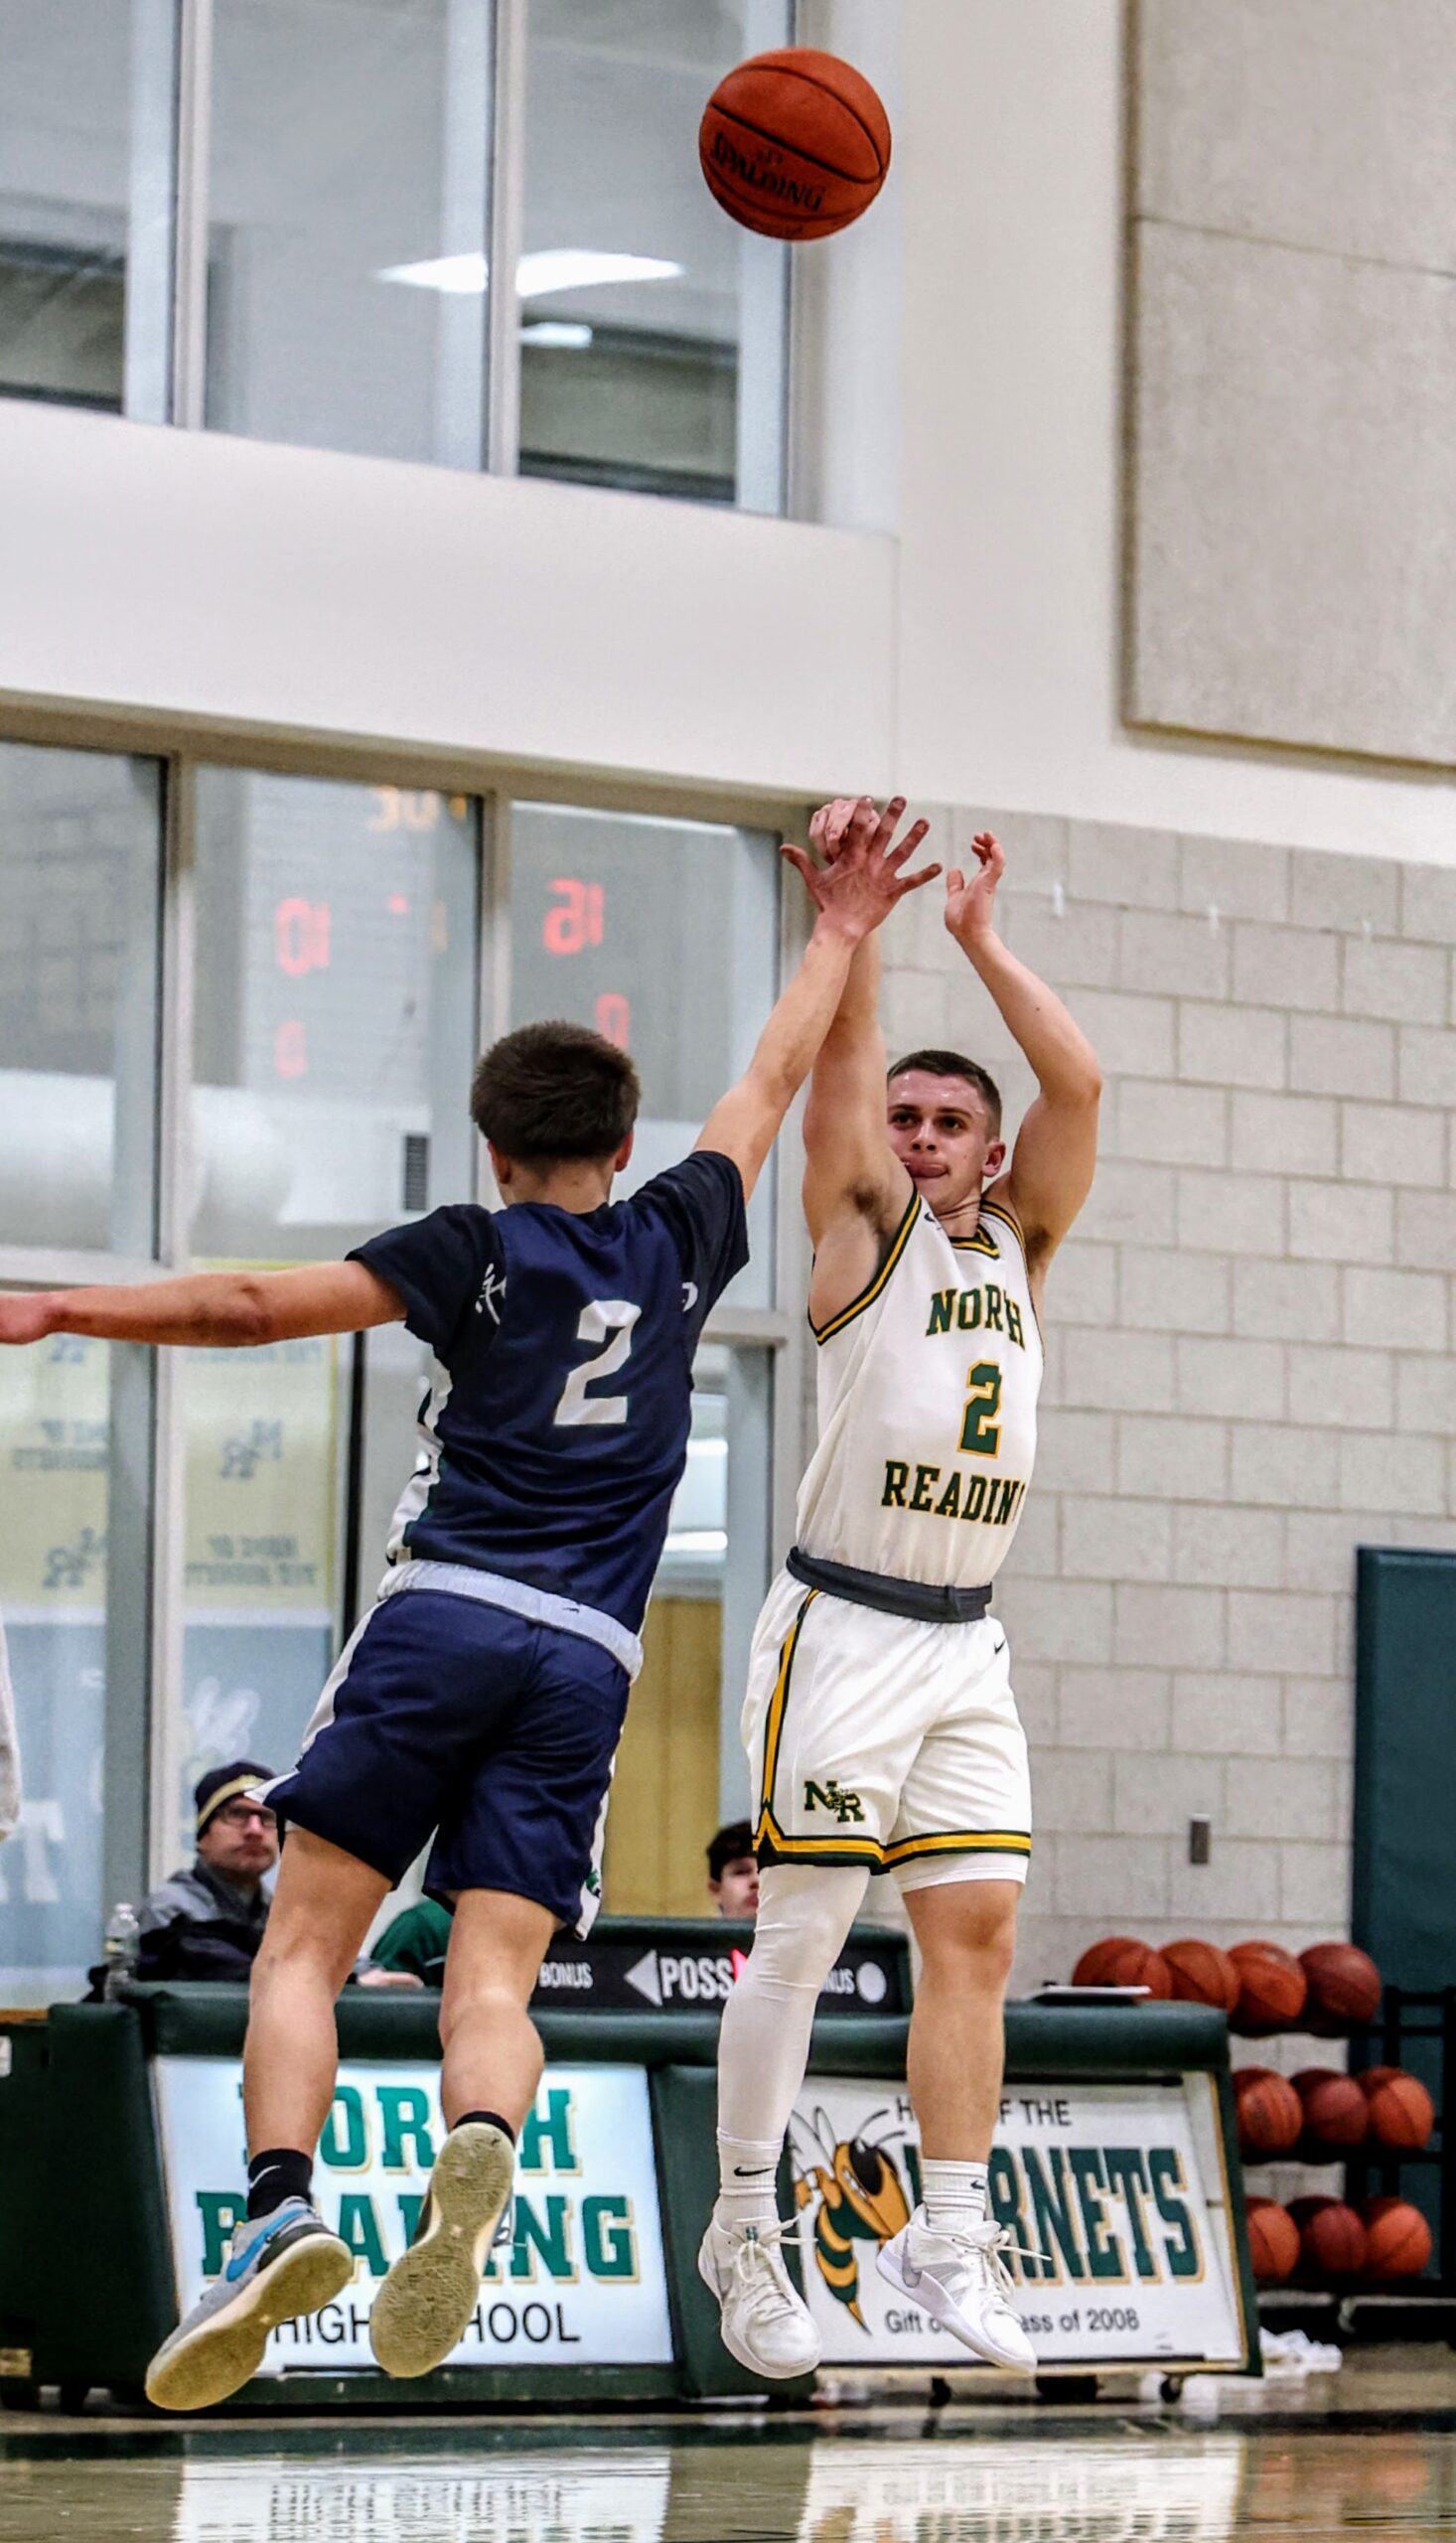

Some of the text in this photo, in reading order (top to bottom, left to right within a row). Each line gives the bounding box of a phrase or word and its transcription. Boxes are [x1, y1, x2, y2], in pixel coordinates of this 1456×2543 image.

[925, 1282, 1026, 1352] NORH
[553, 1299, 643, 1425] 2
[956, 1359, 1002, 1458] 2
[880, 1459, 1026, 1526] READIN
[538, 1961, 593, 1989] BONUS
[821, 1967, 855, 1994] NUS
[237, 2083, 582, 2175] ORH
[1019, 2099, 1073, 2126] THE
[196, 2190, 642, 2285] RANG
[903, 2144, 1206, 2286] RNETS
[460, 2303, 581, 2343] HOOL
[883, 2309, 923, 2334] Gift
[1059, 2309, 1082, 2333] of
[1088, 2308, 1140, 2331] 2008
